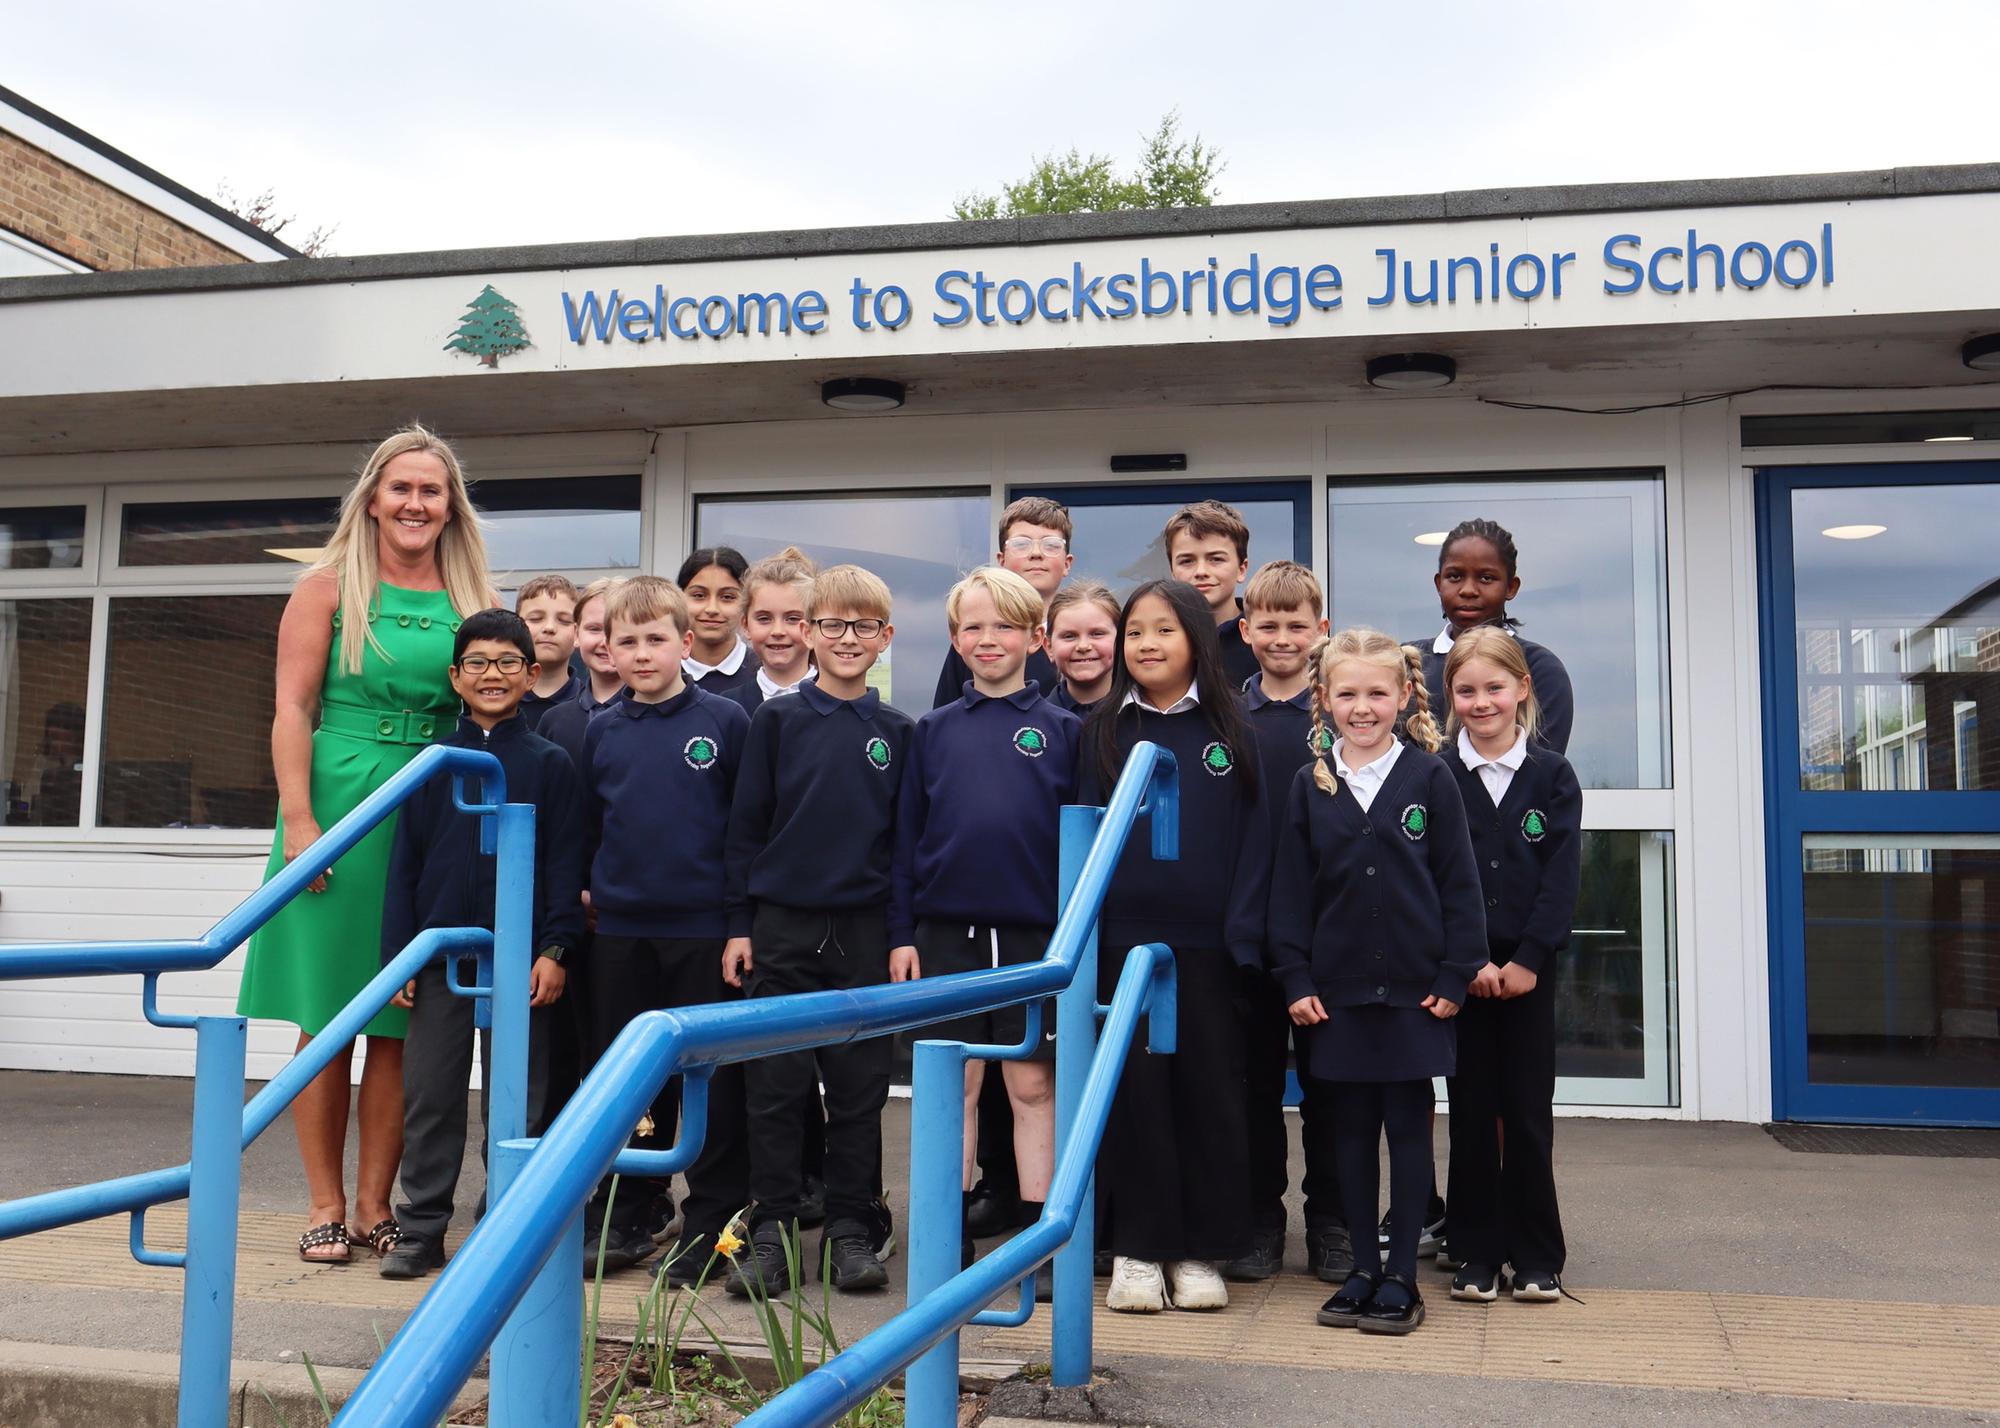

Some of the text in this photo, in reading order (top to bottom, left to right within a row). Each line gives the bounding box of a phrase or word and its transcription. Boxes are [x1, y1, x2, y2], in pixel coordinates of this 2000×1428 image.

[561, 223, 1834, 342] Welcome to Stocksbridge Junior School
